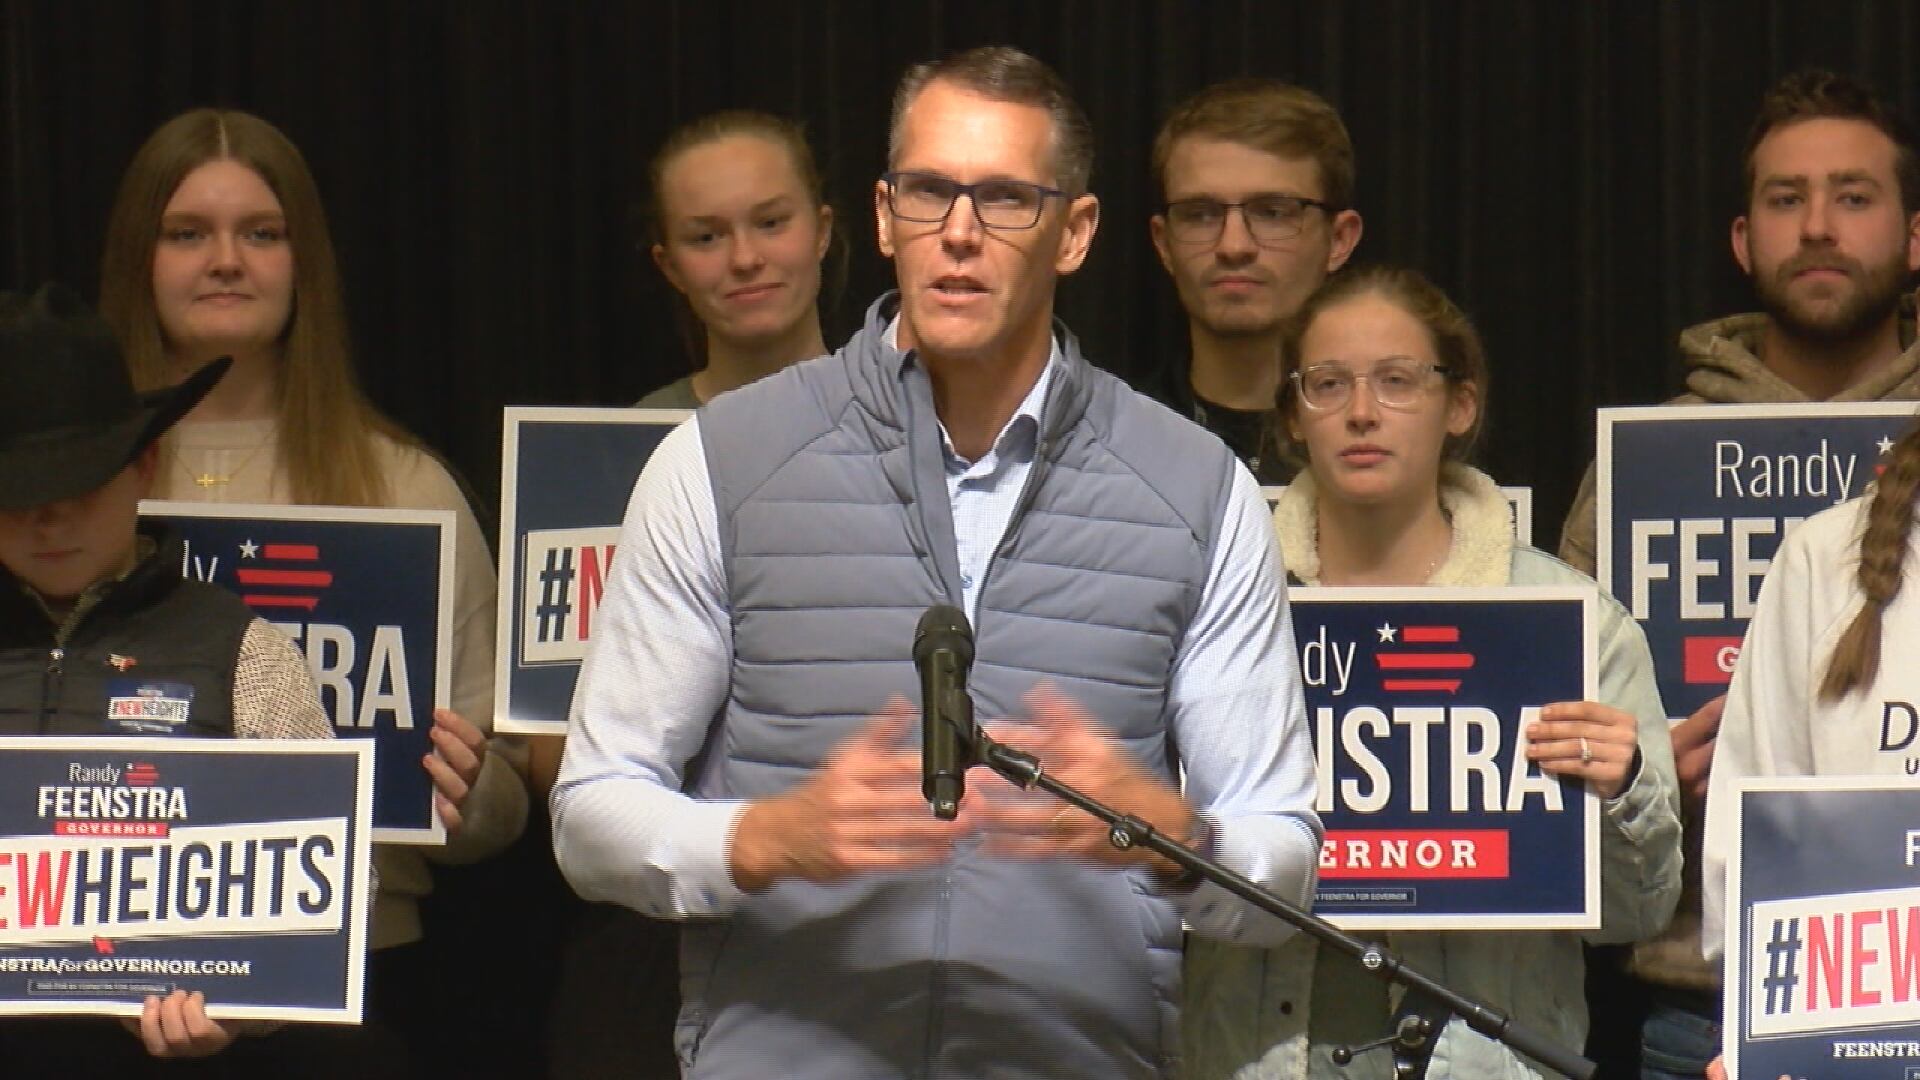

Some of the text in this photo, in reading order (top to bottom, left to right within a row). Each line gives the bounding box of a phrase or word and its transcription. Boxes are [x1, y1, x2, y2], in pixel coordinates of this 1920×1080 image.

[1715, 438, 1857, 505] Randy
[1631, 517, 1806, 620] FEE
[270, 622, 414, 729] RA
[1302, 625, 1357, 696] dy
[37, 786, 188, 819] FEENSTRA
[69, 762, 120, 786] Randy
[65, 822, 158, 834] GOVERNOR
